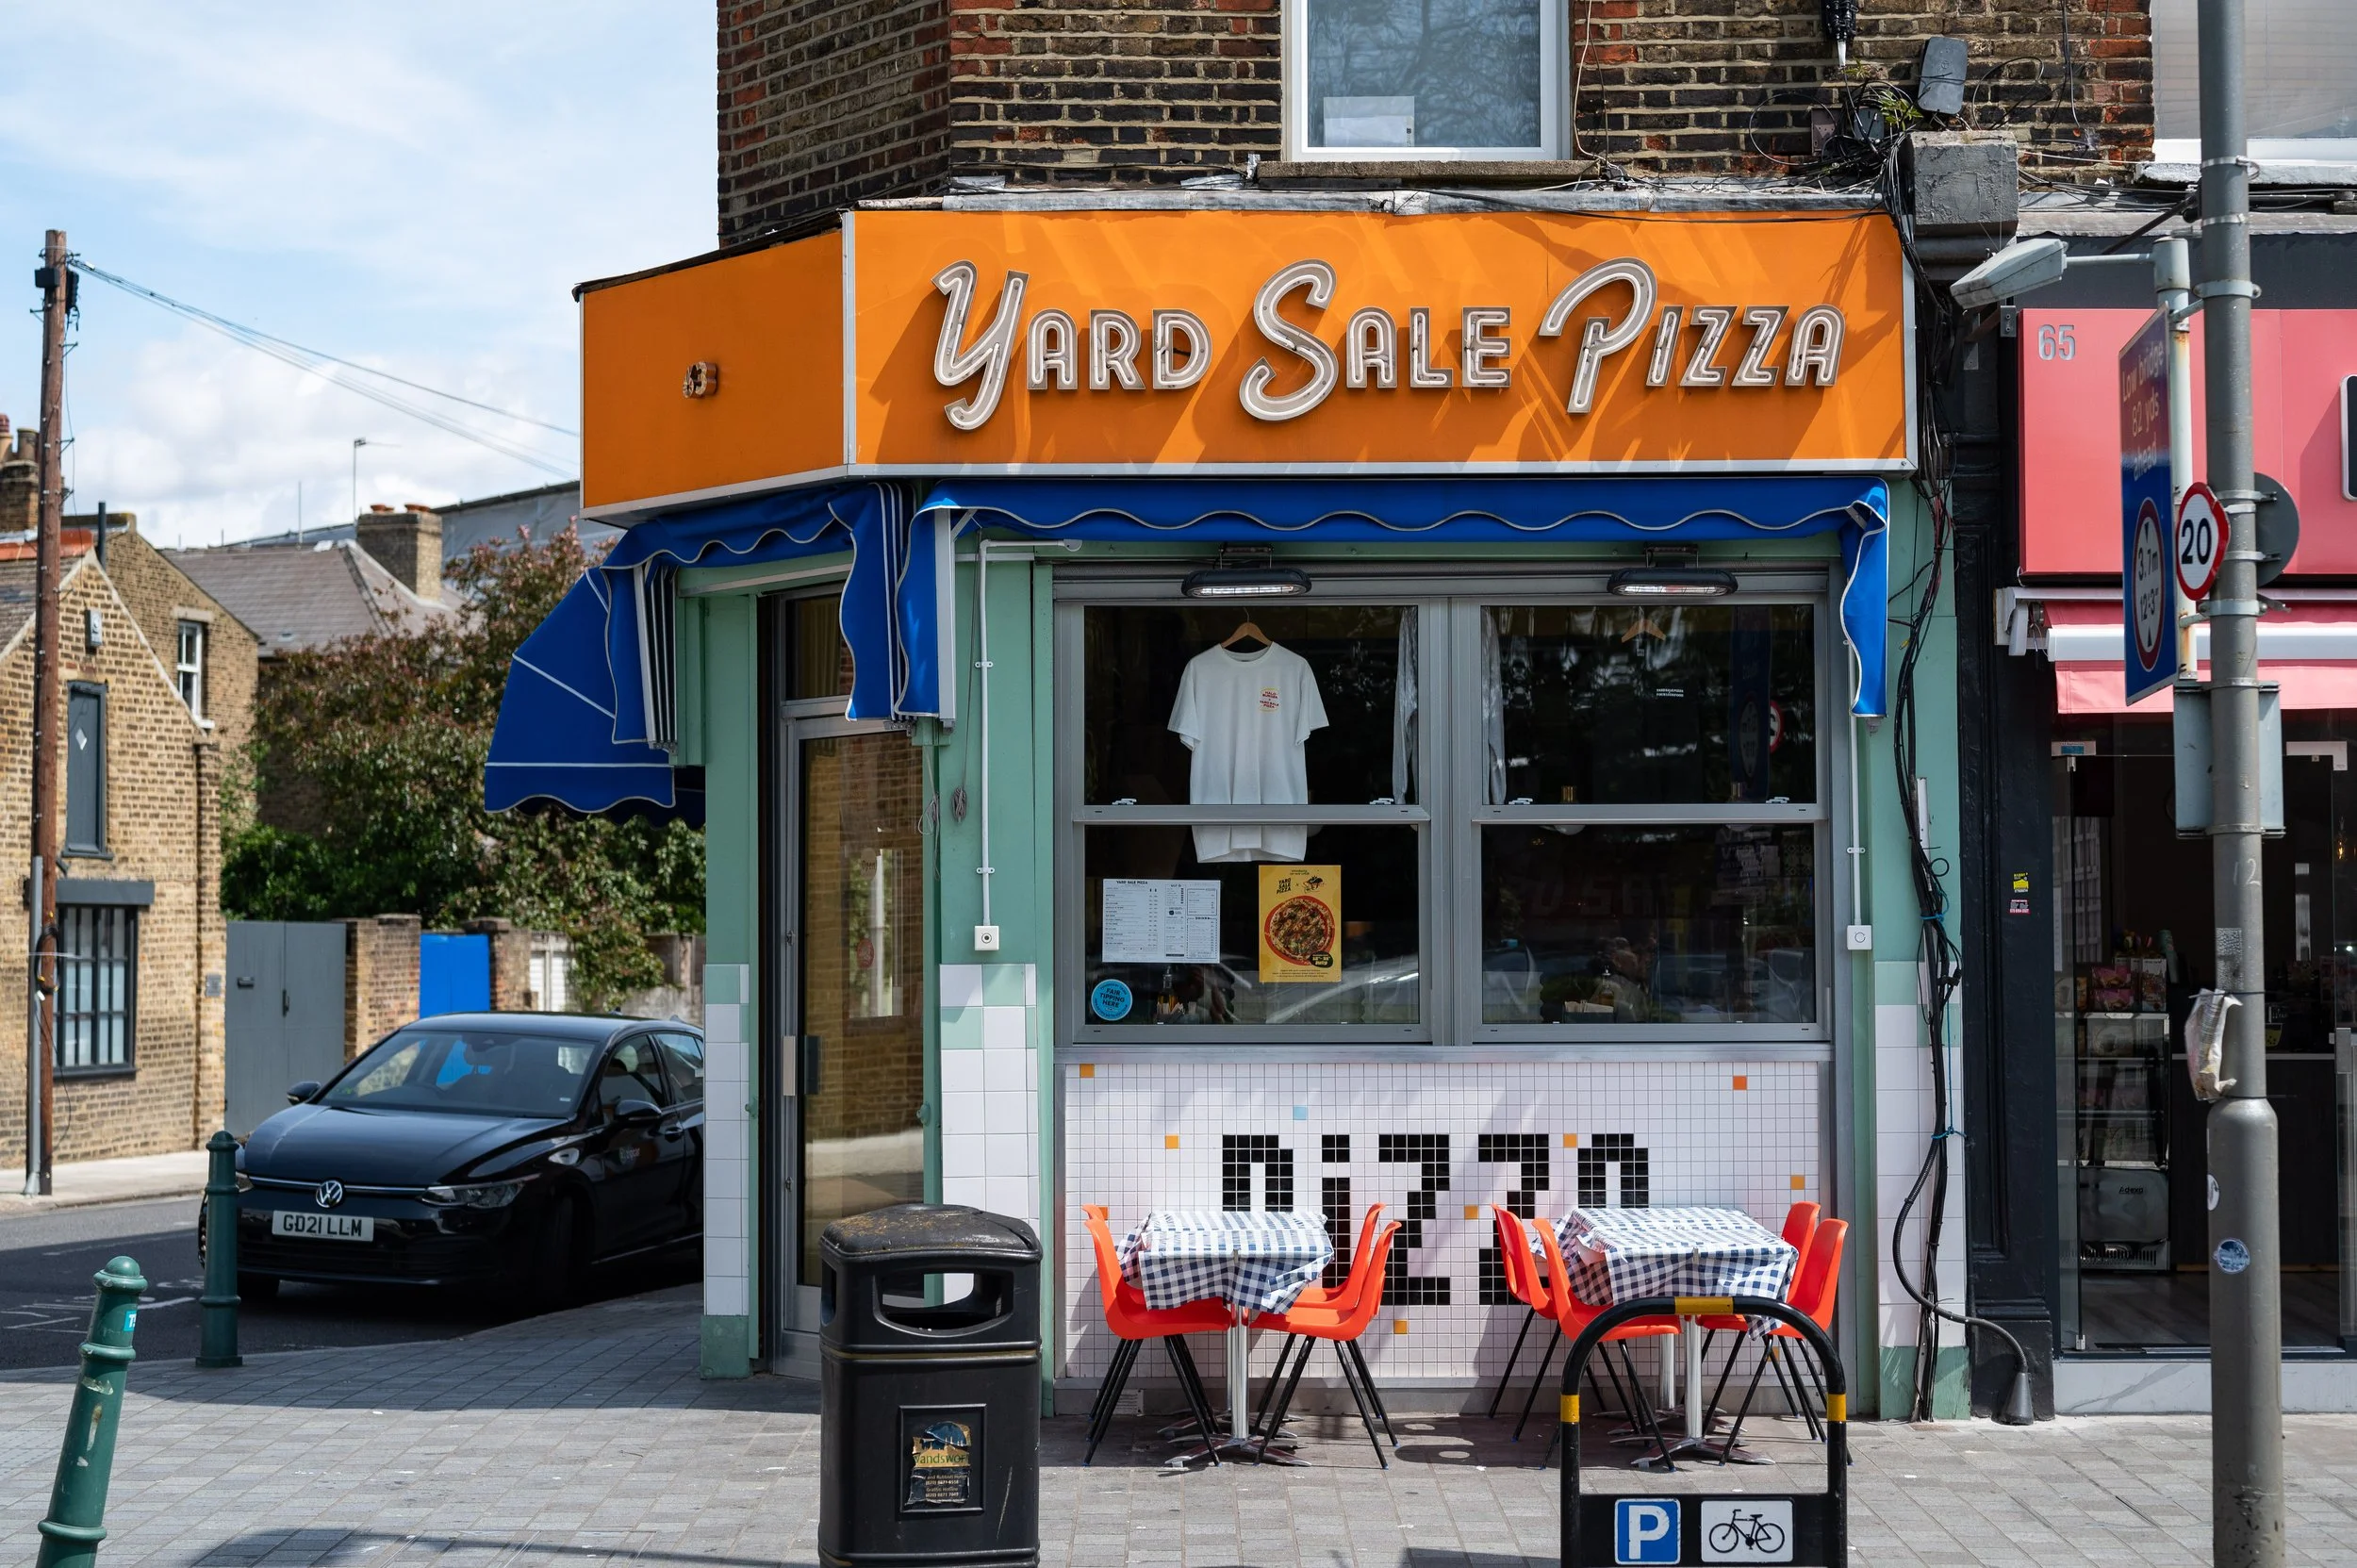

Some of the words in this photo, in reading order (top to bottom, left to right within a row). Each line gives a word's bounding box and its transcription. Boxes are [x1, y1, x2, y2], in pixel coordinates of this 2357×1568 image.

[931, 259, 1211, 431] YARD
[1239, 257, 1509, 422] SALE
[1538, 256, 1845, 414] PIZZA
[2038, 324, 2075, 360] 65
[2122, 367, 2137, 402] Low
[2139, 340, 2164, 385] bridge
[2133, 401, 2143, 437] 82
[2145, 387, 2159, 433] yds
[2134, 432, 2157, 481] ahead
[2181, 519, 2212, 565] 20
[2138, 548, 2159, 581] 3.7m
[2233, 858, 2261, 886] 12
[1100, 992, 1125, 1003] TIPPING
[1102, 999, 1120, 1008] HERE
[1106, 987, 1121, 996] FAIR
[283, 1213, 322, 1234] GD21
[327, 1217, 362, 1237] LLM
[1628, 1505, 1670, 1560] P
